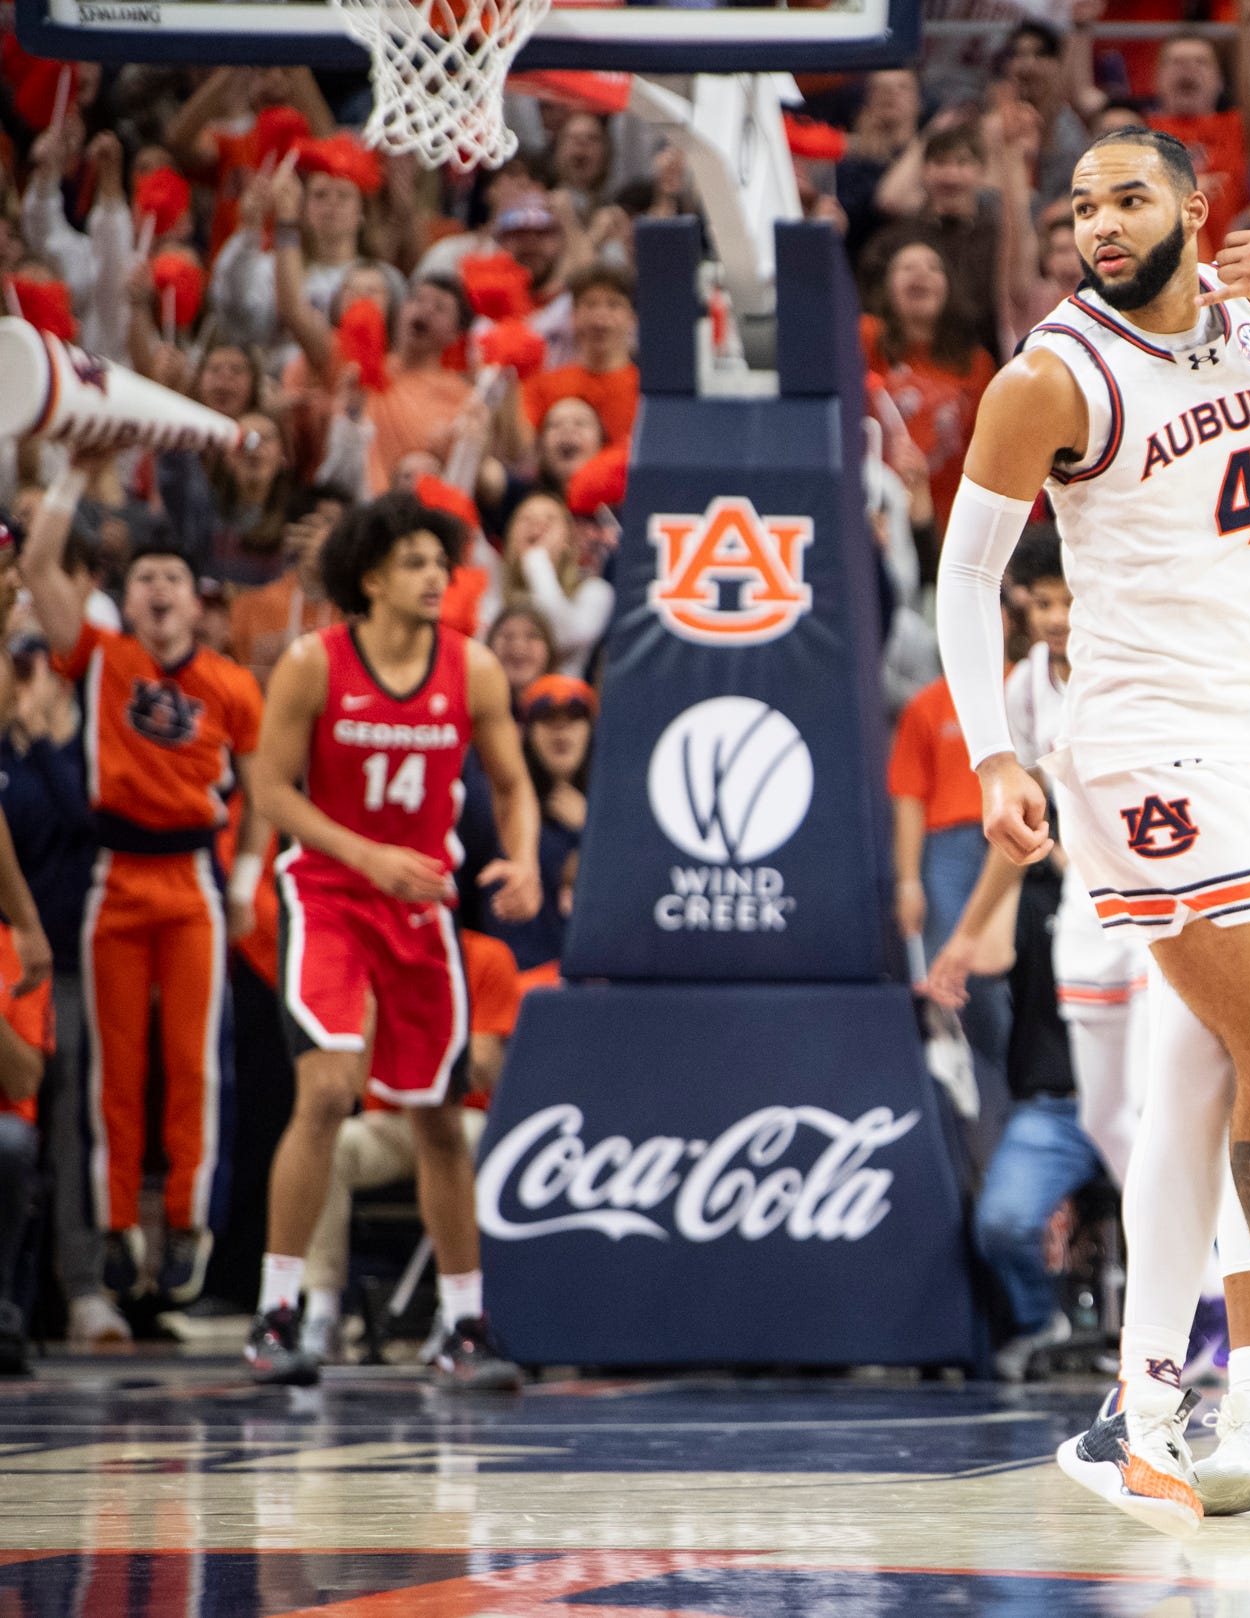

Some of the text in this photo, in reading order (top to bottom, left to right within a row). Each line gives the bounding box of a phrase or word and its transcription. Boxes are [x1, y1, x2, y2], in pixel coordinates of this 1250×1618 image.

[333, 718, 459, 750] GEORGIA
[362, 751, 427, 813] 14
[670, 865, 784, 897] WIND
[654, 894, 788, 932] CREEK
[475, 1103, 922, 1242] Coca-Cola
